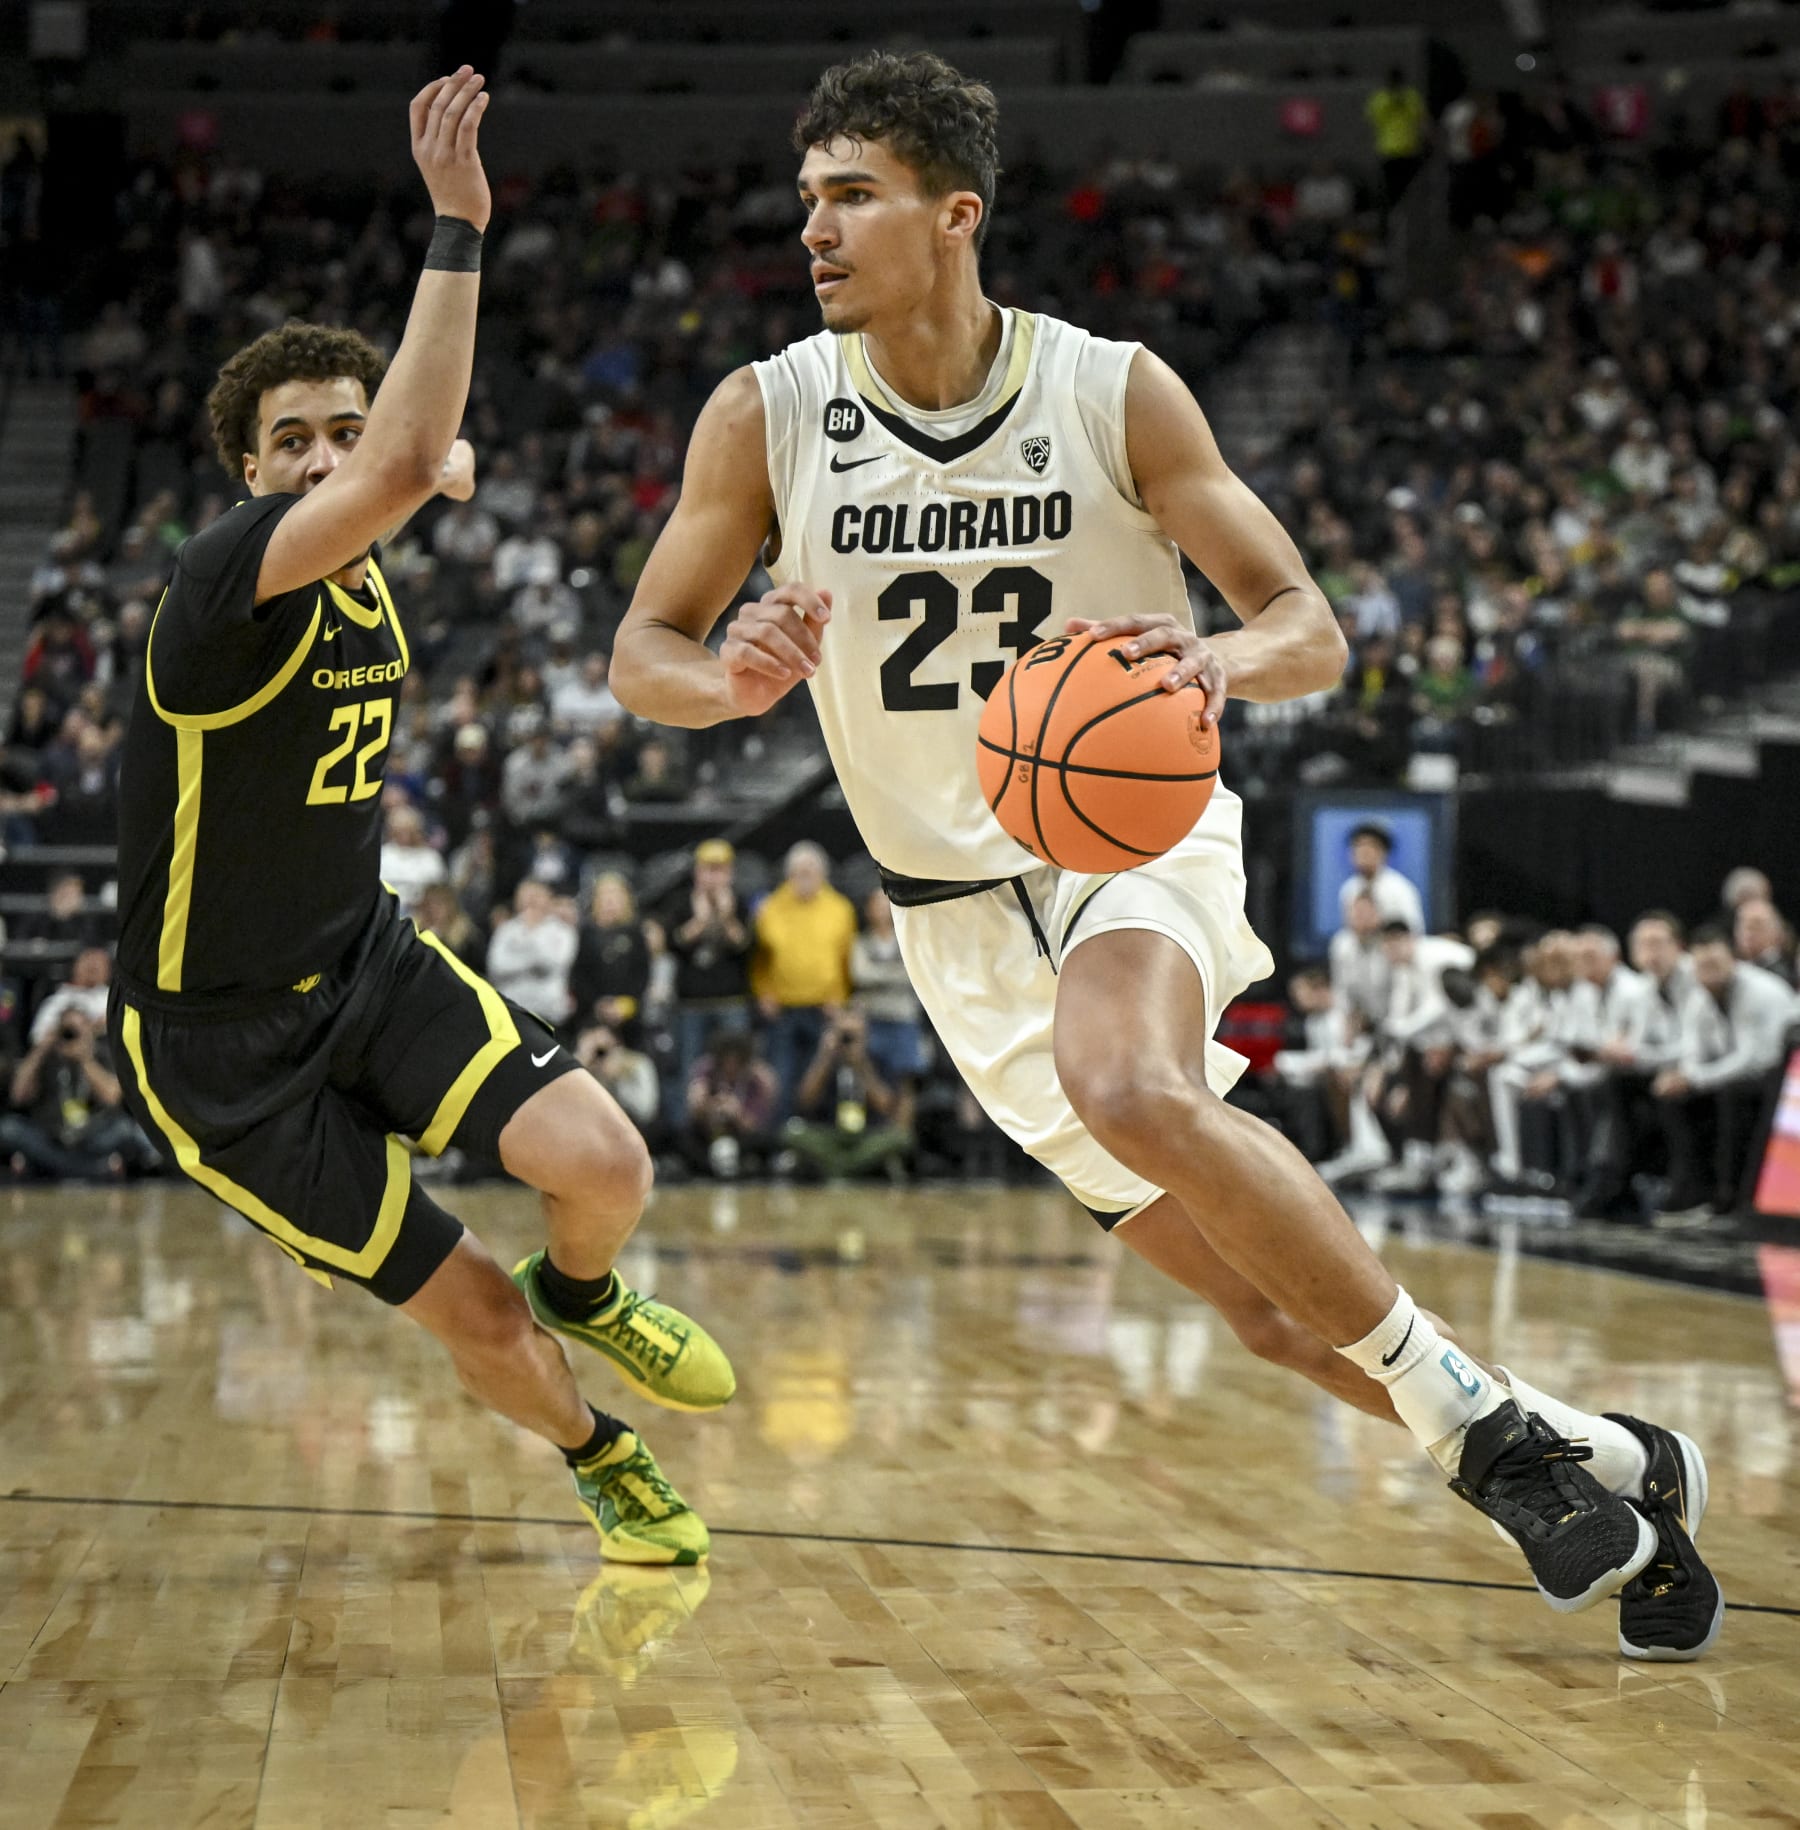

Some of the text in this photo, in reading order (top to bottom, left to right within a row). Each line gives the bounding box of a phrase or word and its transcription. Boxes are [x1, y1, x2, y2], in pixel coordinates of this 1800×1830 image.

[828, 407, 857, 431] BH
[1022, 437, 1049, 461] PAC
[1030, 452, 1045, 467] 12
[831, 490, 1072, 554] COLORADO
[877, 566, 1053, 711] 23
[305, 697, 392, 806] 22
